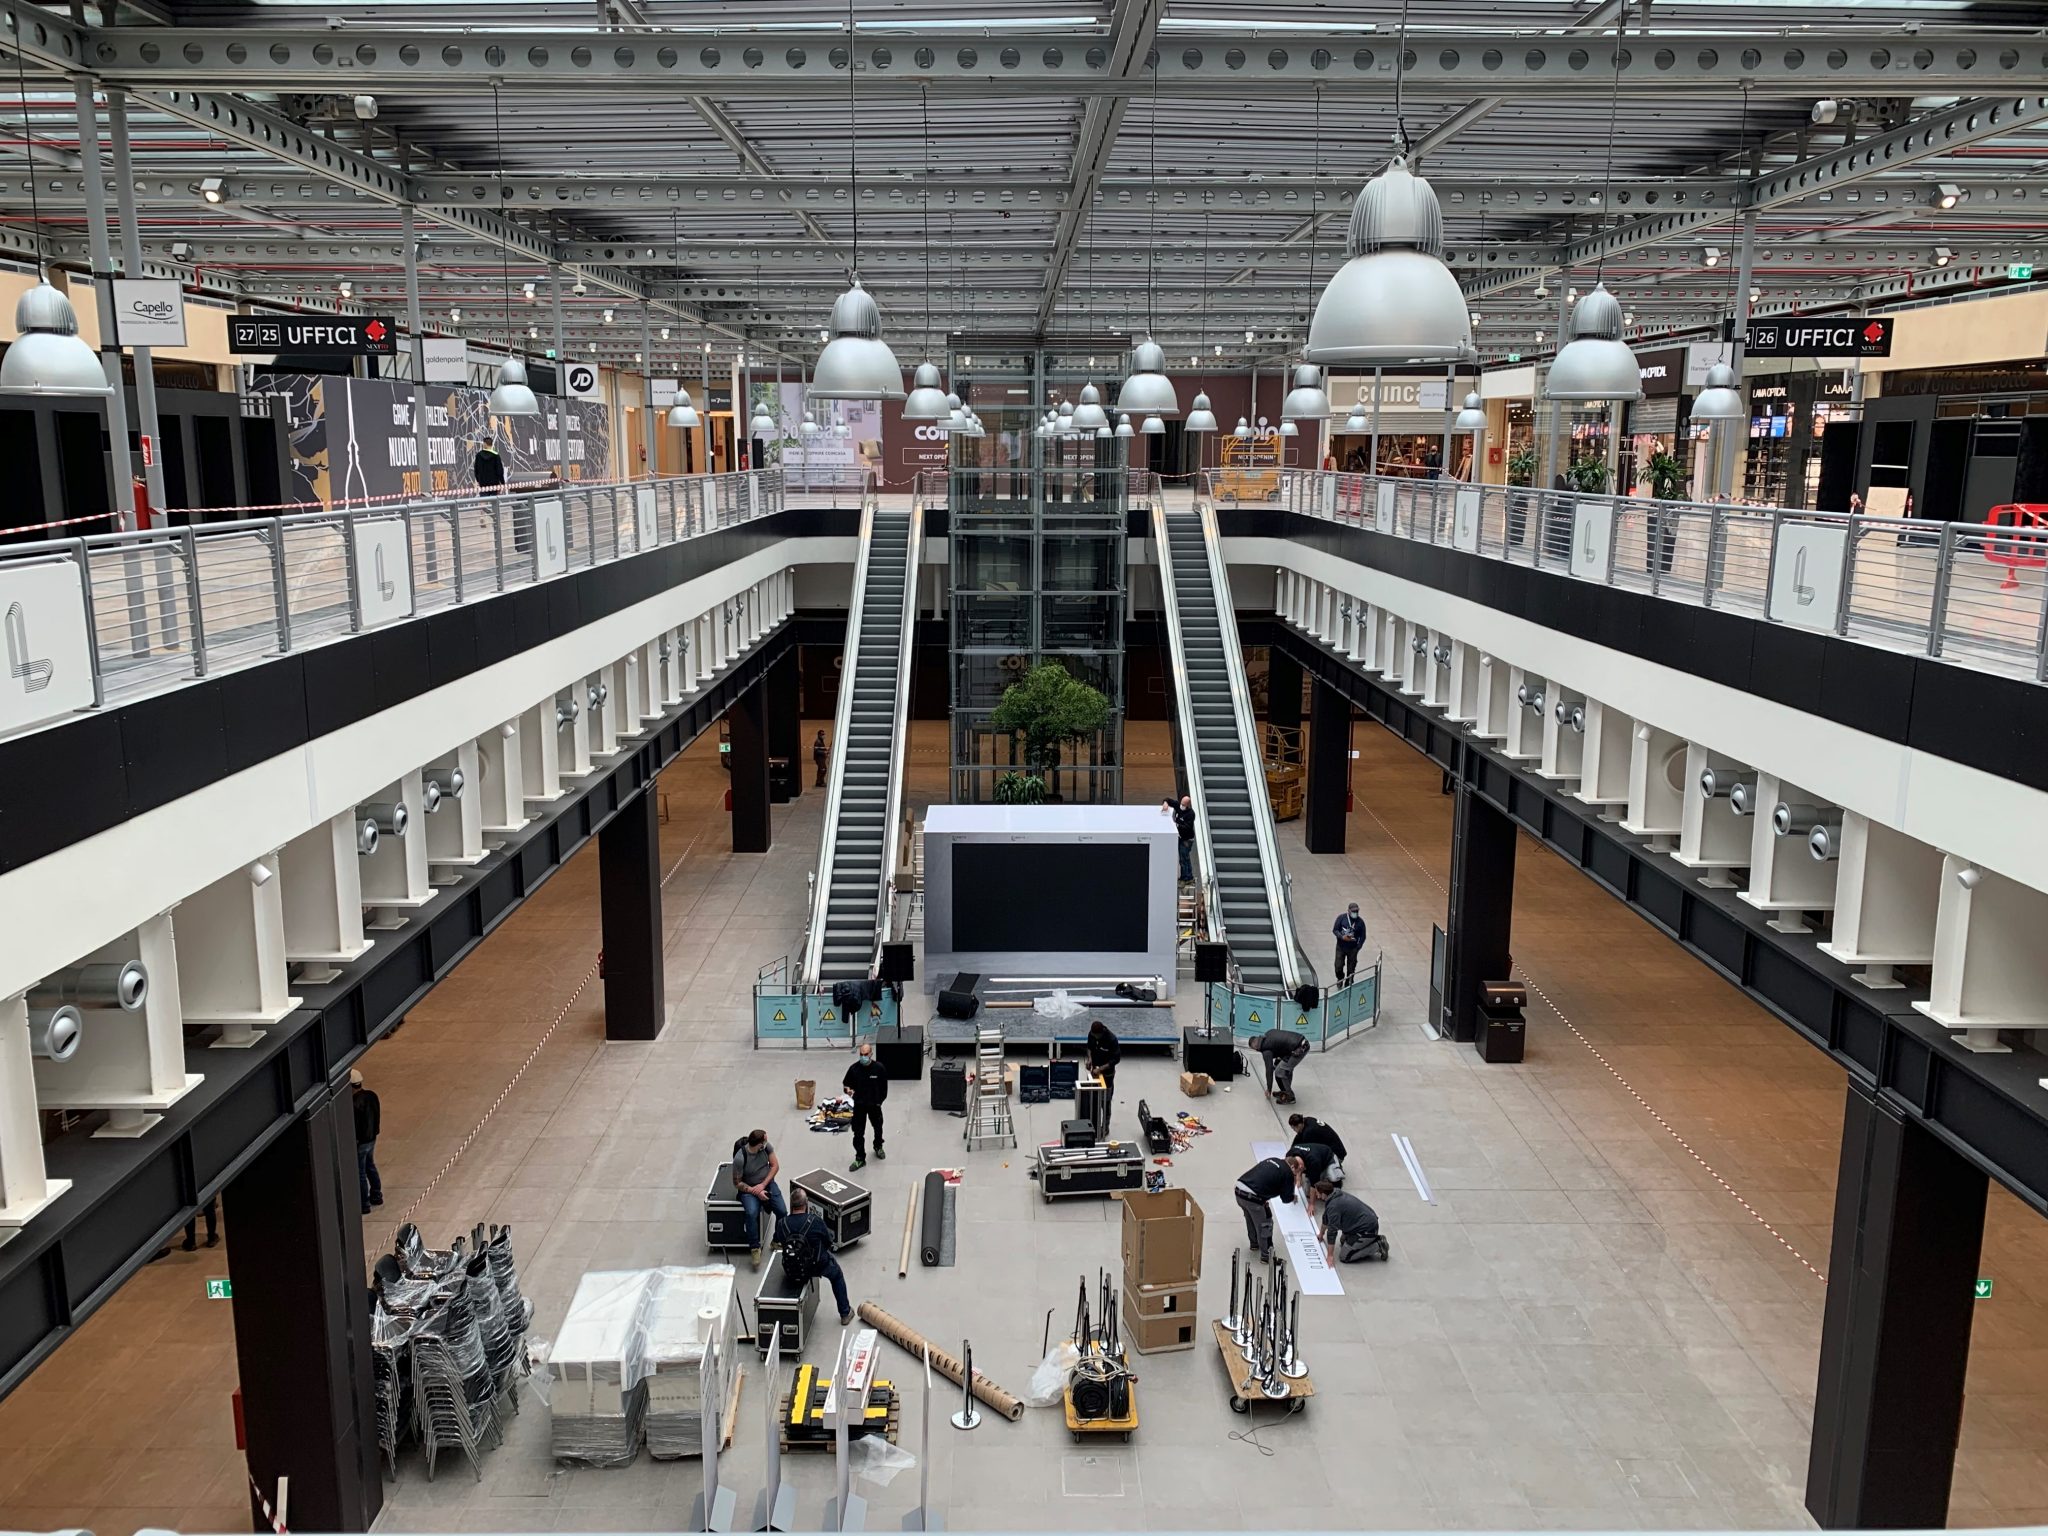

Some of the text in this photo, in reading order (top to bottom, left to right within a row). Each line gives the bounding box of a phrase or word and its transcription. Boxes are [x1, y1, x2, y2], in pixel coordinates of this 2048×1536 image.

[133, 301, 173, 315] Capello
[239, 326, 357, 345] 27 25 UFFICI
[1758, 332, 1775, 344] 26
[1785, 328, 1855, 347] UFFICI
[425, 356, 464, 364] goldenpoint
[1647, 365, 1667, 378] OPTICAL
[572, 373, 592, 387] JD
[1753, 387, 1787, 398] LAMA OPTICAL
[392, 404, 411, 426] GAME
[425, 405, 449, 427] THLETICS
[388, 437, 456, 467] NUOVA ERTURA
